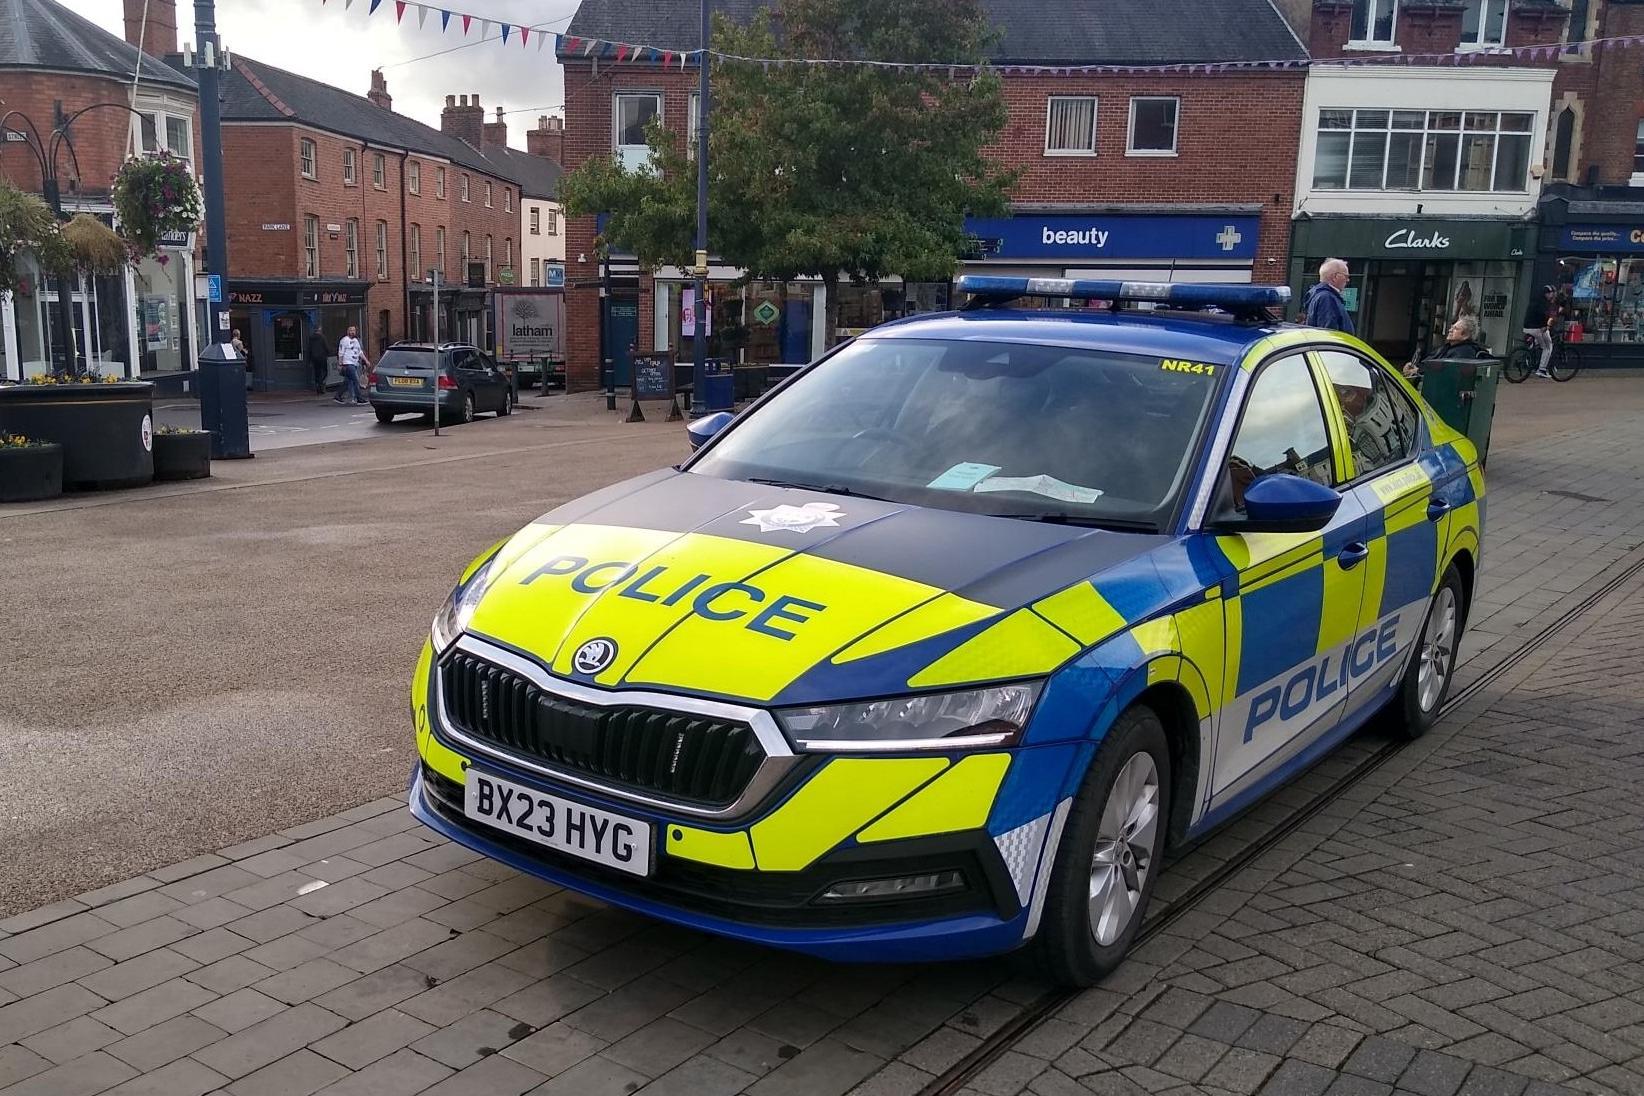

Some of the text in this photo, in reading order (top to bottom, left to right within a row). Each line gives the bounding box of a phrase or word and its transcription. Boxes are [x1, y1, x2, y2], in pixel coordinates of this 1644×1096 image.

[161, 230, 187, 241] anders
[1042, 227, 1108, 247] beauty
[1385, 229, 1450, 248] Clarks
[512, 323, 553, 337] latham
[1161, 359, 1215, 376] NR41
[520, 555, 827, 641] POLICE
[1243, 612, 1401, 744] POLICE
[477, 777, 634, 863] BX23 HYG
